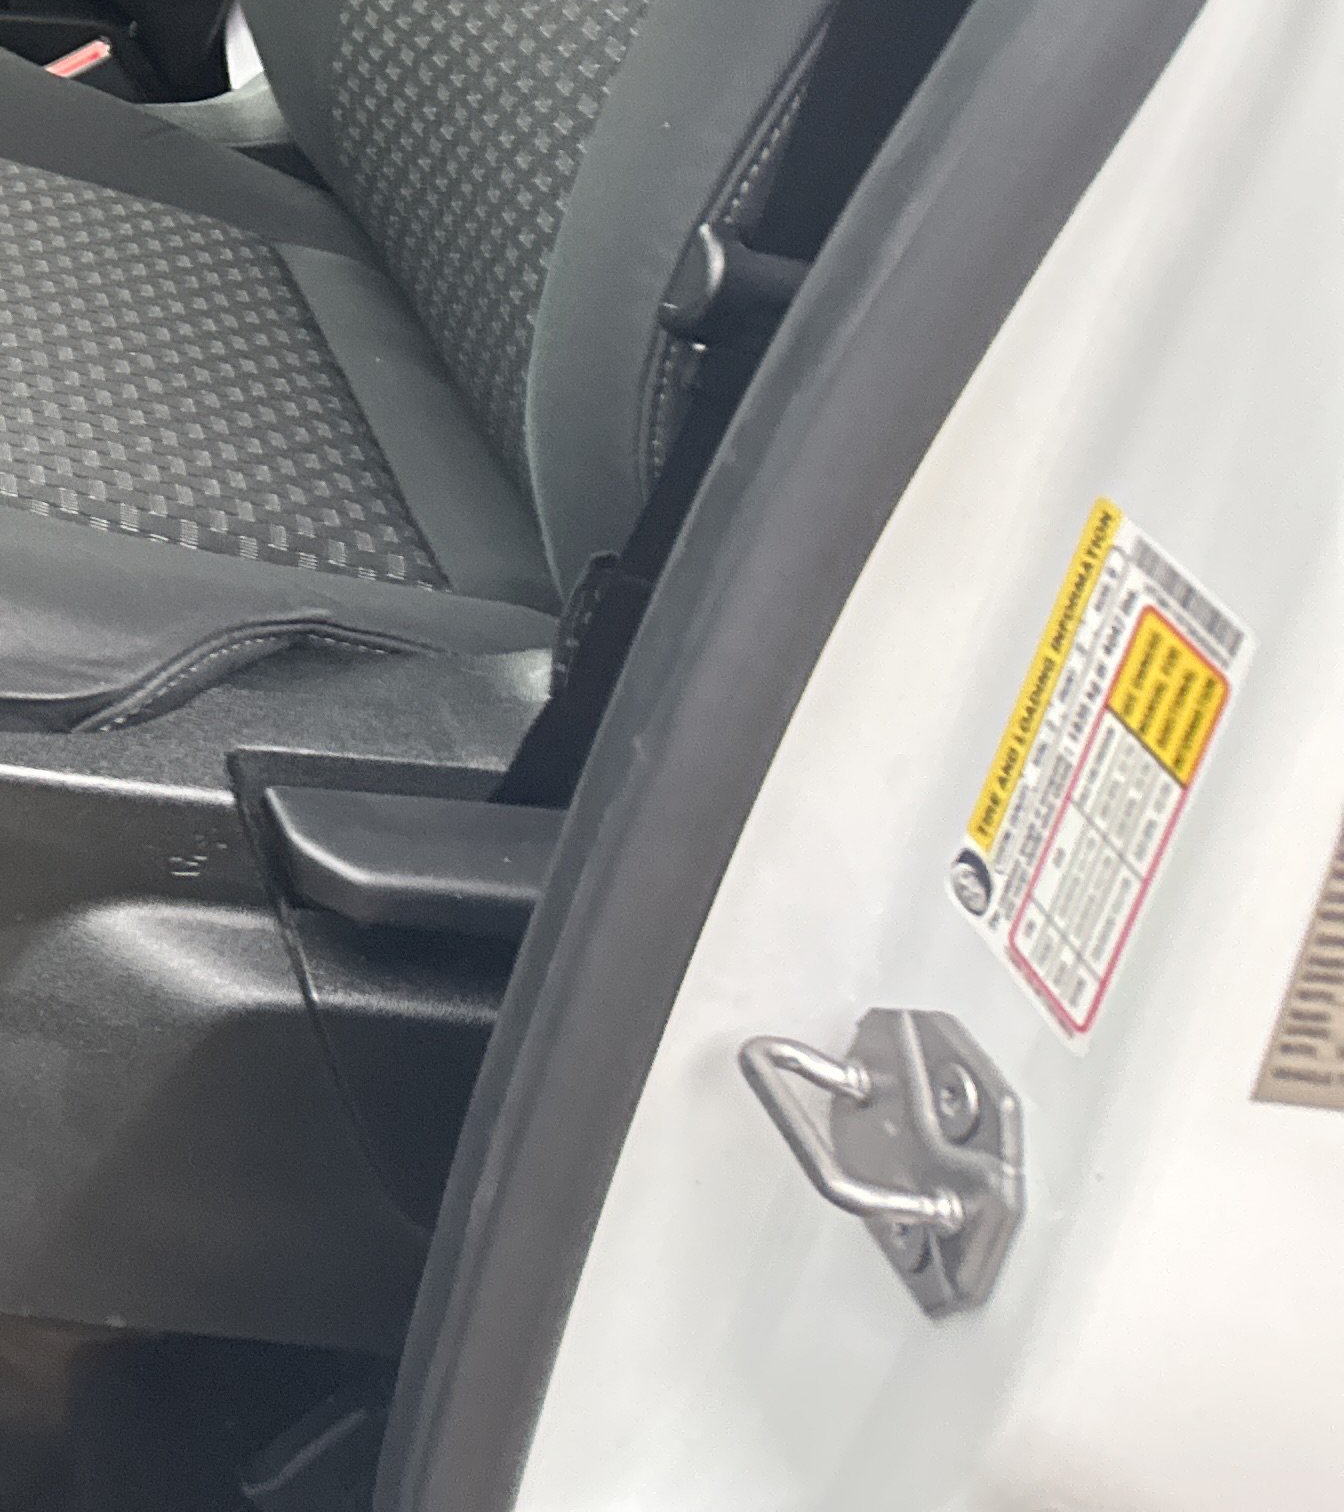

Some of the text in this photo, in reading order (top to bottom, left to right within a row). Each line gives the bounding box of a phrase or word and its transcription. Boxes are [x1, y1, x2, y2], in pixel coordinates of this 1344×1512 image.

[976, 790, 1002, 841] TIRE
[995, 744, 1020, 792] AND
[1013, 653, 1056, 747] LOADING
[1047, 507, 1115, 655] INFORMATION
